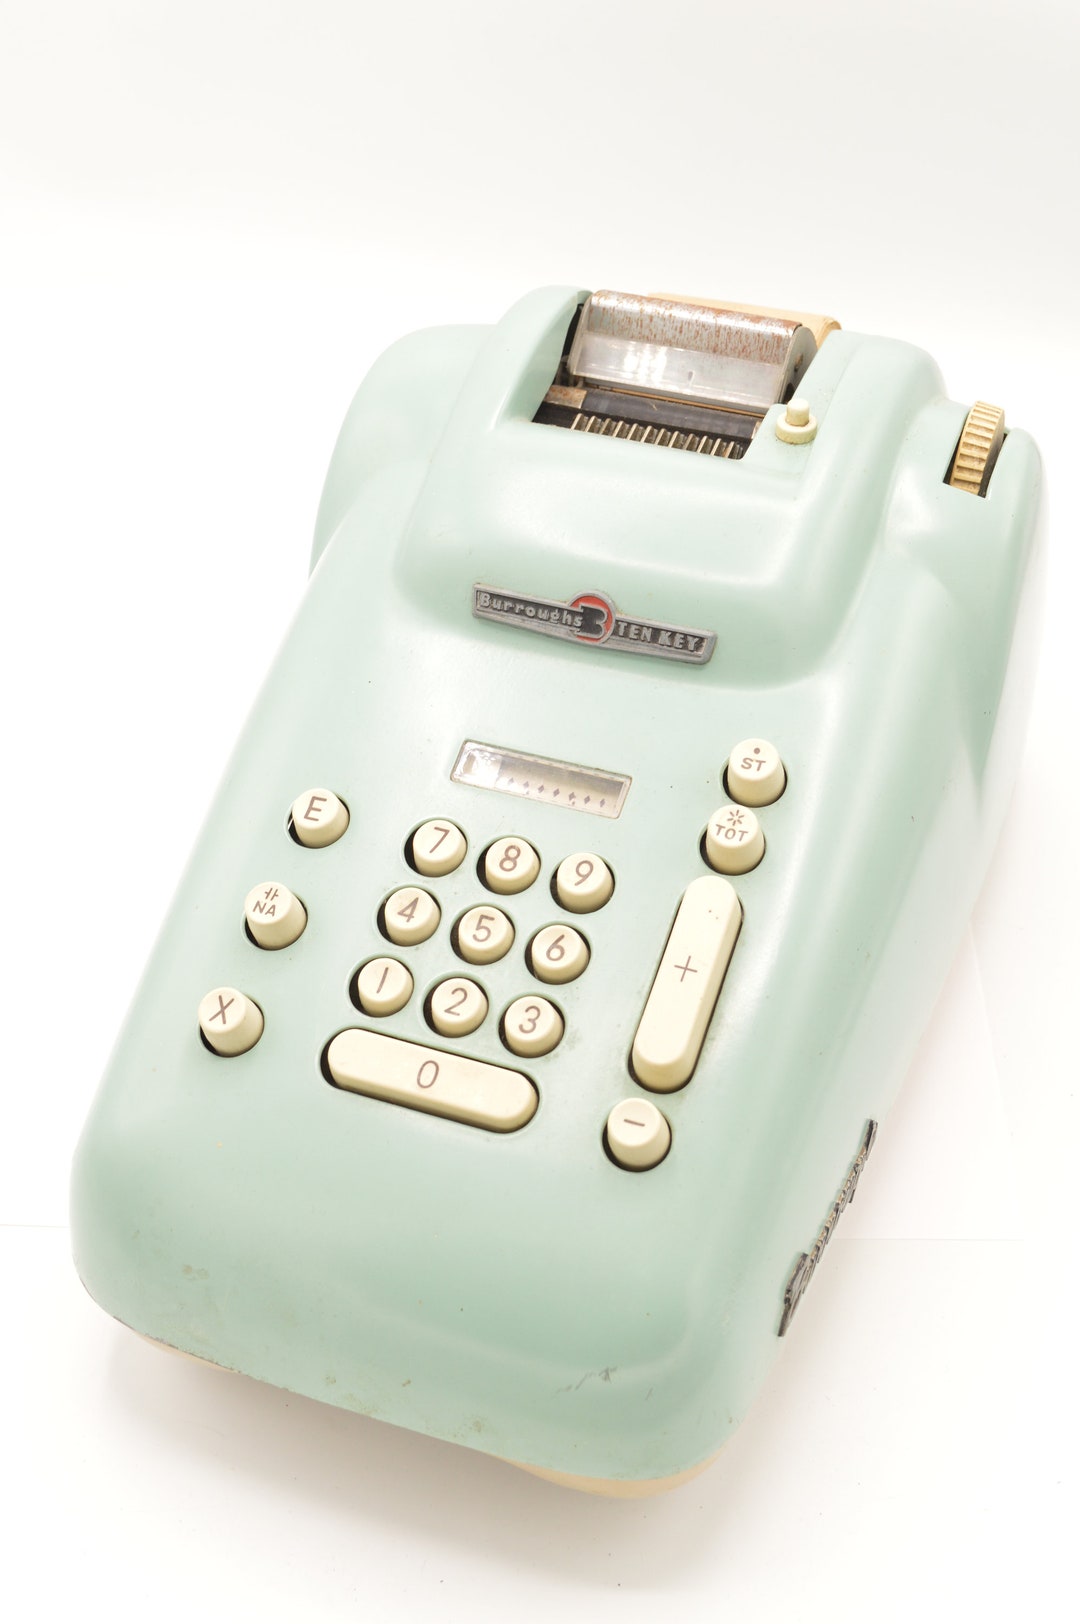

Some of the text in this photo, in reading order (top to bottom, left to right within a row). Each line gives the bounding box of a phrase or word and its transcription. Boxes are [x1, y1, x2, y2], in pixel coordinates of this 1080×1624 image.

[478, 591, 583, 628] Burroughs
[617, 621, 701, 653] TEN KEY
[740, 757, 767, 772] ST
[303, 796, 328, 821] E
[428, 826, 450, 853] 7
[715, 823, 749, 842] TOT
[498, 845, 521, 872] 8
[573, 859, 594, 886] 9
[252, 900, 277, 917] NA
[397, 896, 420, 923] 4
[472, 914, 495, 942] 5
[545, 934, 565, 961] 6
[208, 994, 235, 1024] X
[443, 987, 468, 1016] 2
[518, 1005, 542, 1034] 3
[416, 1059, 440, 1089] 0
